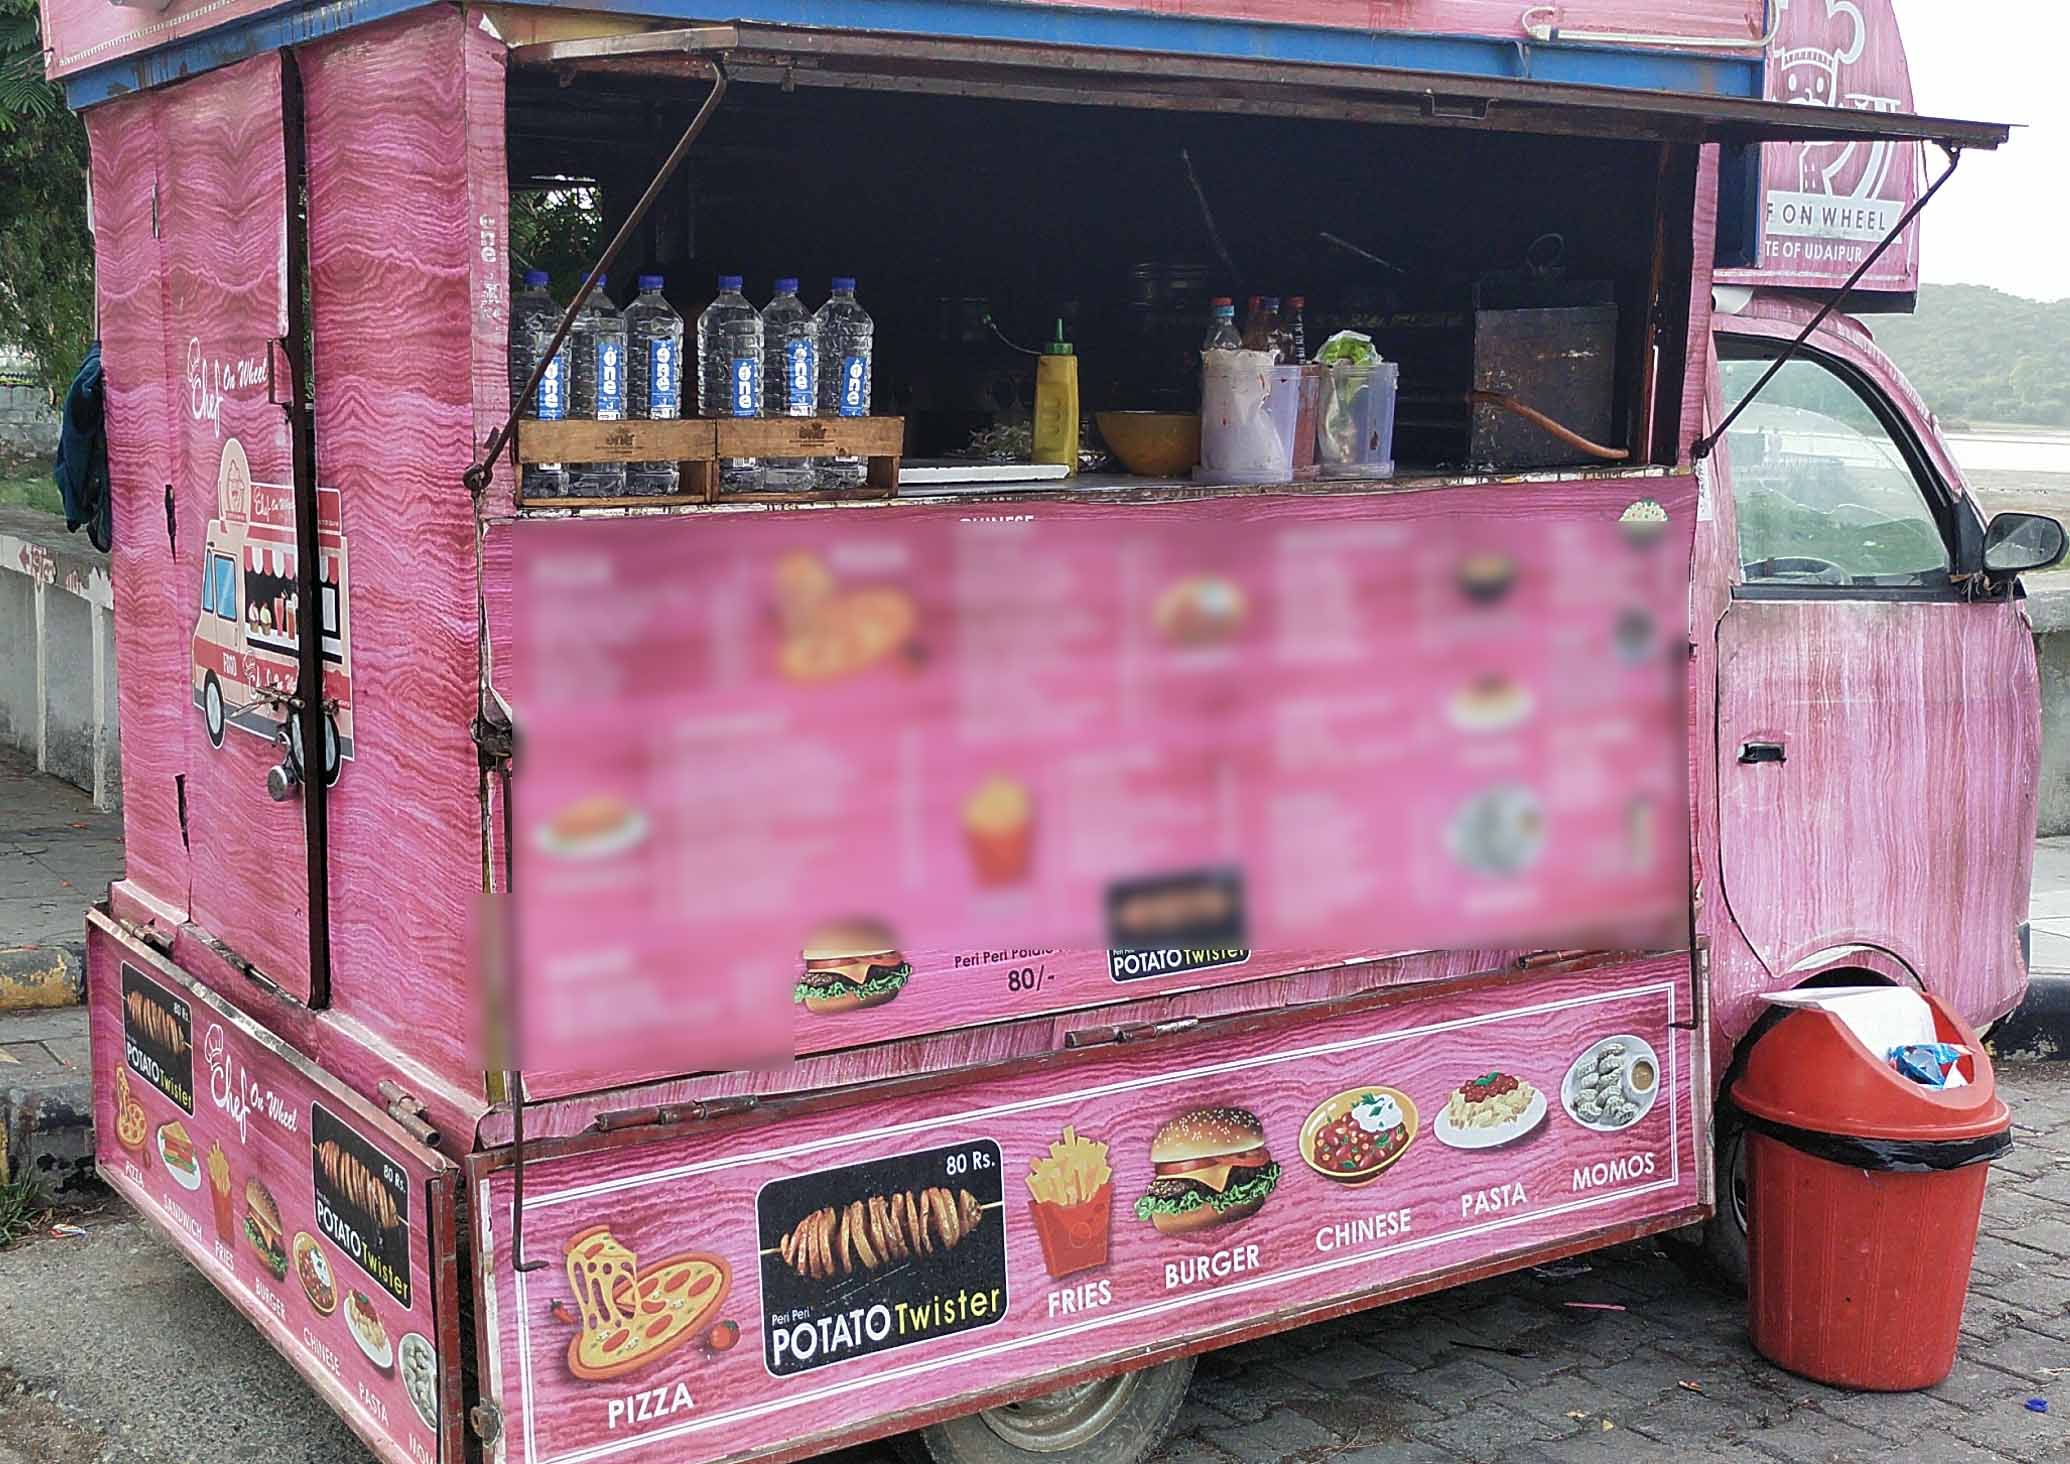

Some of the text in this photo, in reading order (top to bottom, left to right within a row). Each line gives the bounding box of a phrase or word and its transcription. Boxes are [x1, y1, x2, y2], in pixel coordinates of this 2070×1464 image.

[1782, 203, 1813, 226] ON
[1822, 207, 1886, 231] WHEEL
[1782, 241, 1801, 259] OF
[1804, 243, 1862, 263] UDAIPUR
[191, 356, 269, 439] Chef On Wheel
[954, 952, 980, 969] Peri
[1007, 964, 1055, 992] 80/-
[1113, 949, 1183, 977] POTATO
[126, 1040, 192, 1109] POTATO Twister
[210, 1054, 297, 1145] Chef On Wheel
[125, 1159, 145, 1188] PIZZA
[383, 1164, 407, 1193] 80 Rs.
[946, 1148, 997, 1177] 80 Rs.
[1571, 1152, 1657, 1192] MOMOS
[163, 1193, 203, 1242] SANDWICH
[1460, 1181, 1528, 1218] PASTA
[316, 1199, 409, 1300] POTATO Twister
[1314, 1208, 1412, 1253] CHINESE
[214, 1239, 235, 1272] FRIES
[1163, 1244, 1261, 1290] BURGER
[255, 1276, 286, 1320] BURGER
[771, 1308, 811, 1327] Peri Peri
[1046, 1279, 1113, 1318] FRIES
[772, 1287, 1001, 1367] POTATO Twister
[303, 1327, 341, 1377] CHINESE
[358, 1380, 389, 1426] PASTA
[607, 1382, 695, 1430] PIZZA
